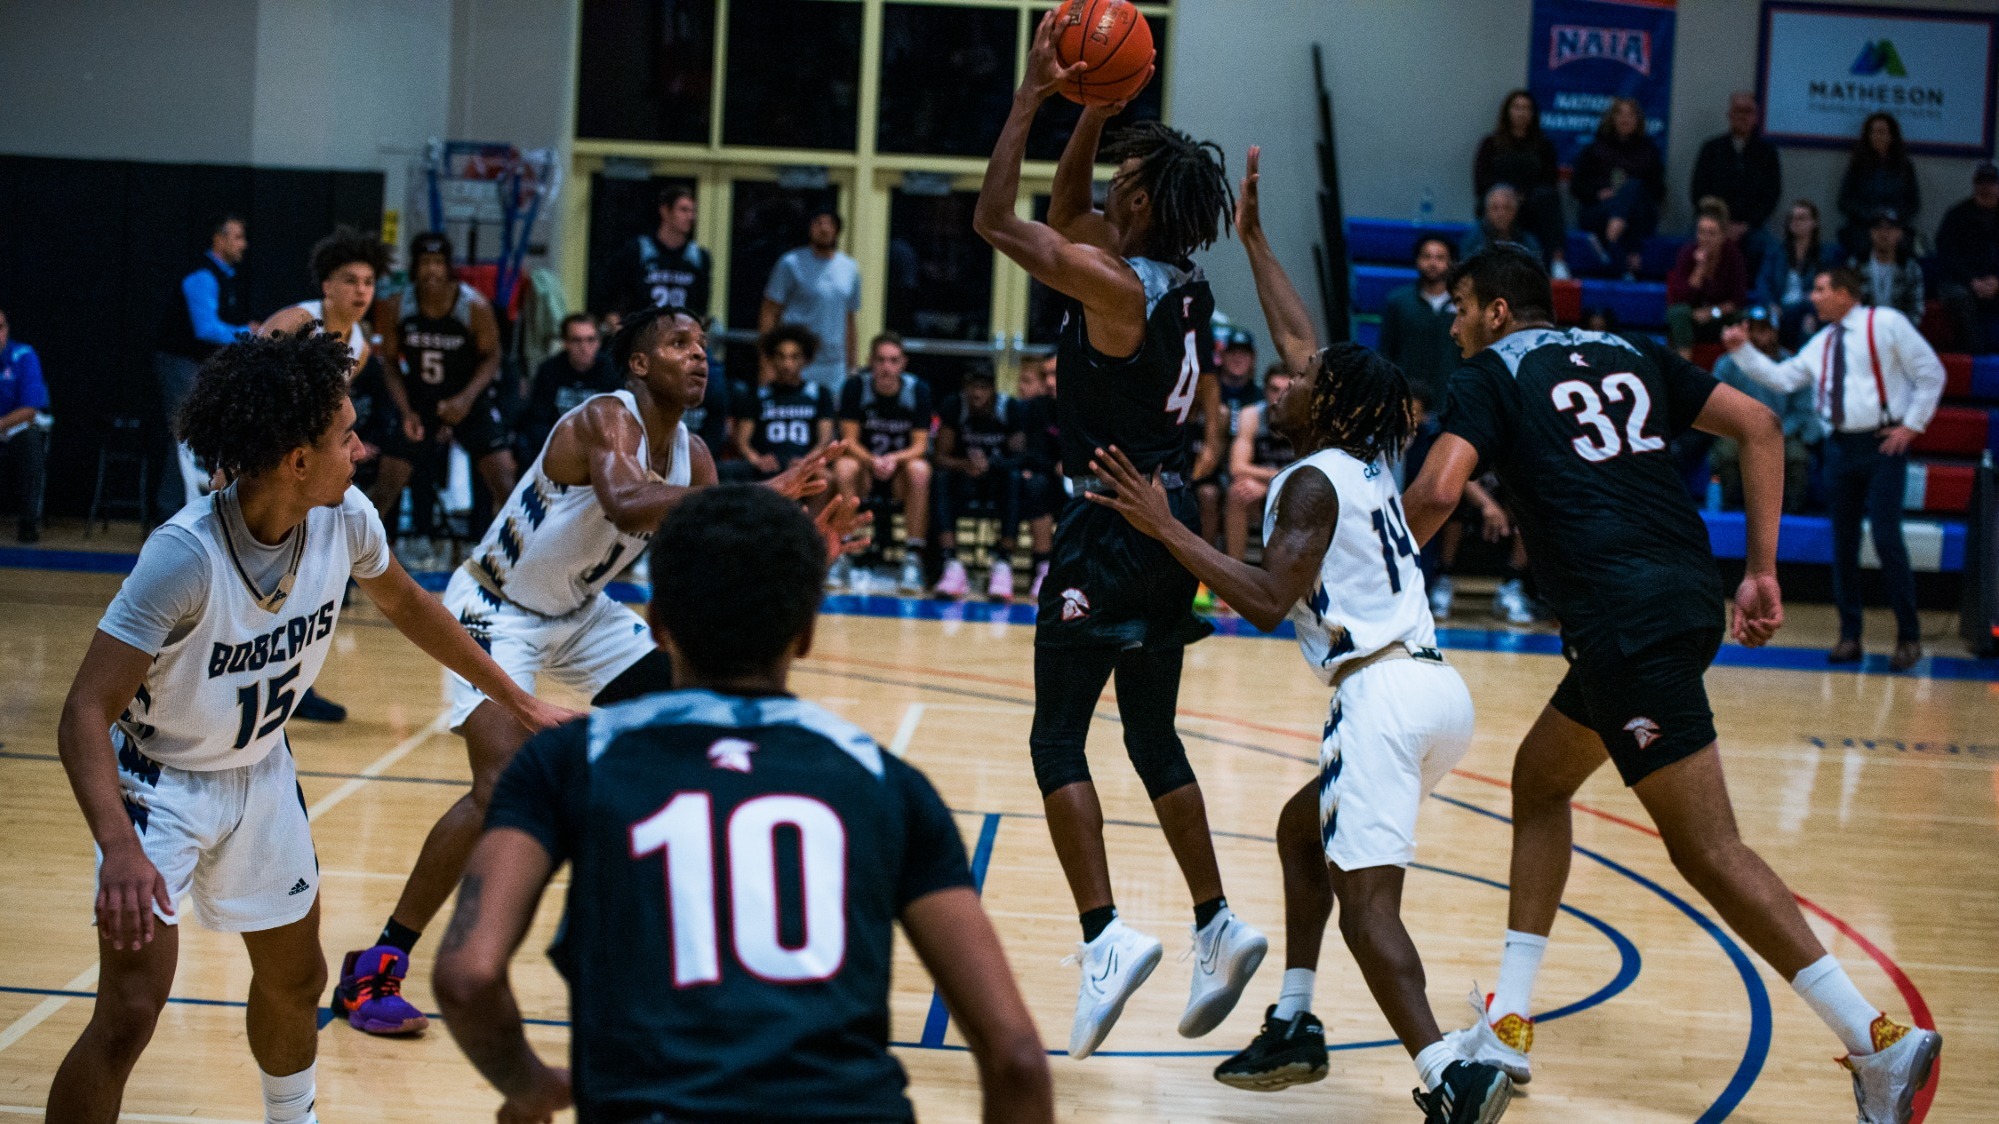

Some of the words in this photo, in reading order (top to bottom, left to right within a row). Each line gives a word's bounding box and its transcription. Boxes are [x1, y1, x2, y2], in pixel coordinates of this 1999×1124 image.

[1557, 30, 1643, 64] NAIA
[1808, 80, 1944, 107] MATHESON
[405, 332, 465, 350] JESSUP
[421, 350, 444, 384] 5
[1165, 330, 1200, 426] 4
[1551, 371, 1666, 462] 32
[1371, 494, 1421, 595] 14
[208, 600, 335, 679] BOBCATS
[233, 660, 302, 750] 15
[627, 790, 848, 990] 10
